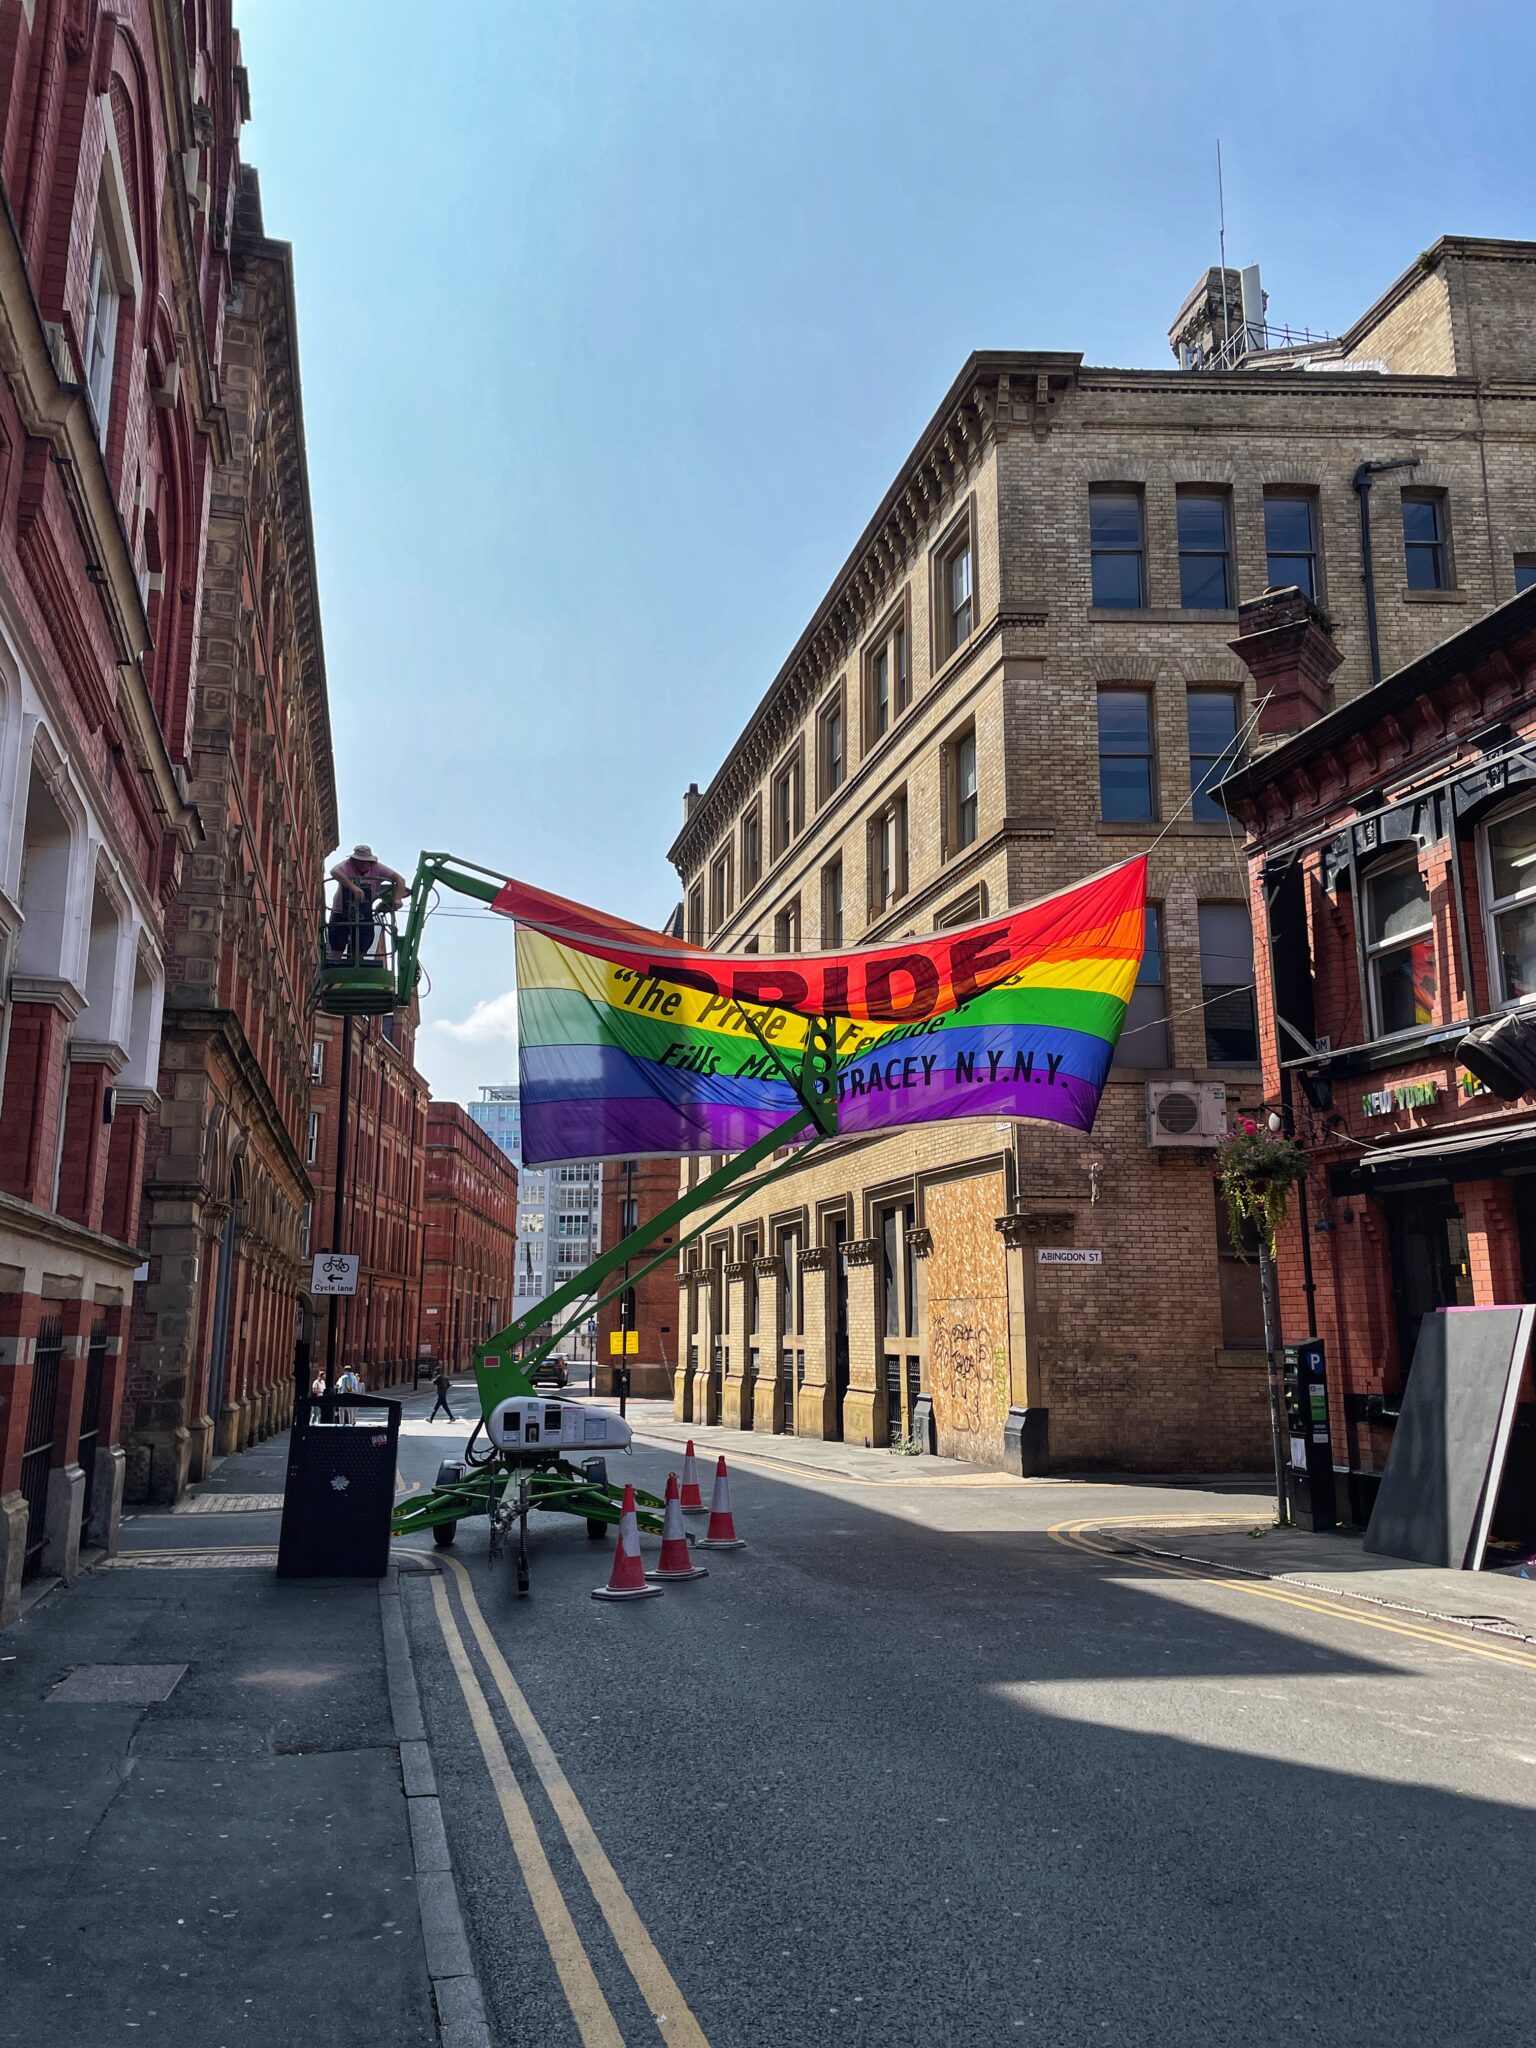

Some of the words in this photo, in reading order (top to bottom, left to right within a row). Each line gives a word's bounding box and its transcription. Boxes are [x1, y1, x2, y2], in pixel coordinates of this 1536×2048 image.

[656, 1042, 722, 1079] Fills
[1361, 1090, 1394, 1117] NEW
[1395, 1081, 1438, 1110] YORK
[1041, 1252, 1086, 1262] ABINGDON
[1088, 1253, 1100, 1262] ST
[314, 1283, 336, 1292] Cycle
[337, 1284, 354, 1292] lane
[1310, 1353, 1321, 1371] P
